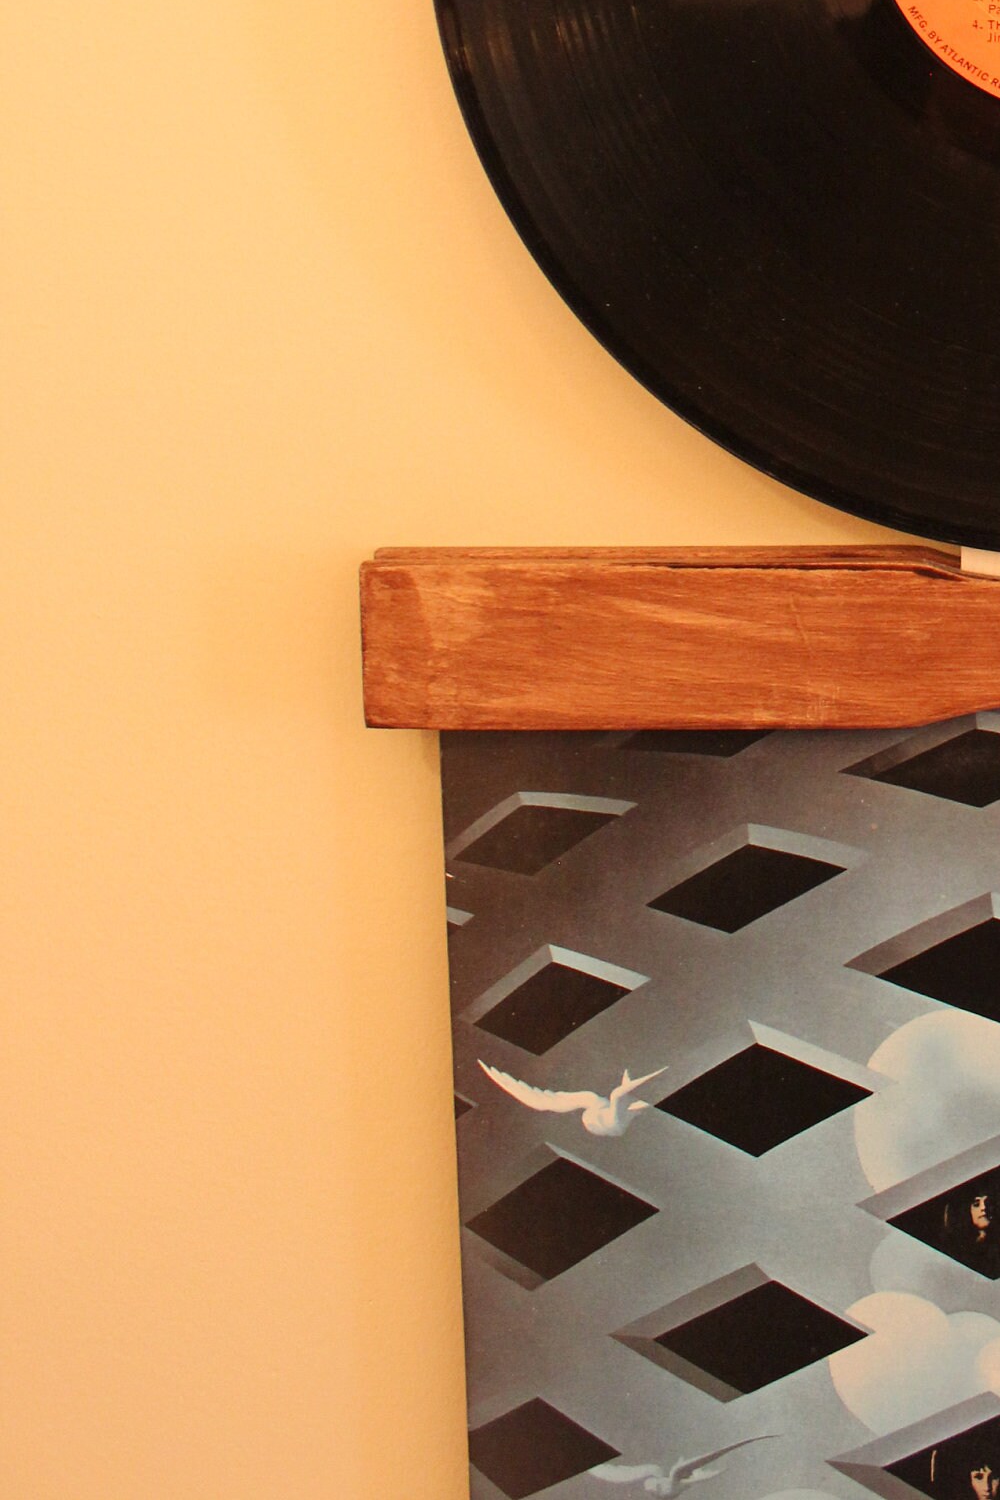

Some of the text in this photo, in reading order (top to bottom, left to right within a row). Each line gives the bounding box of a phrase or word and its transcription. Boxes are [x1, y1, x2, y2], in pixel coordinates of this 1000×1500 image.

[907, 5, 927, 32] MFG.
[928, 31, 943, 44] BY
[940, 44, 990, 81] ATLANTIC
